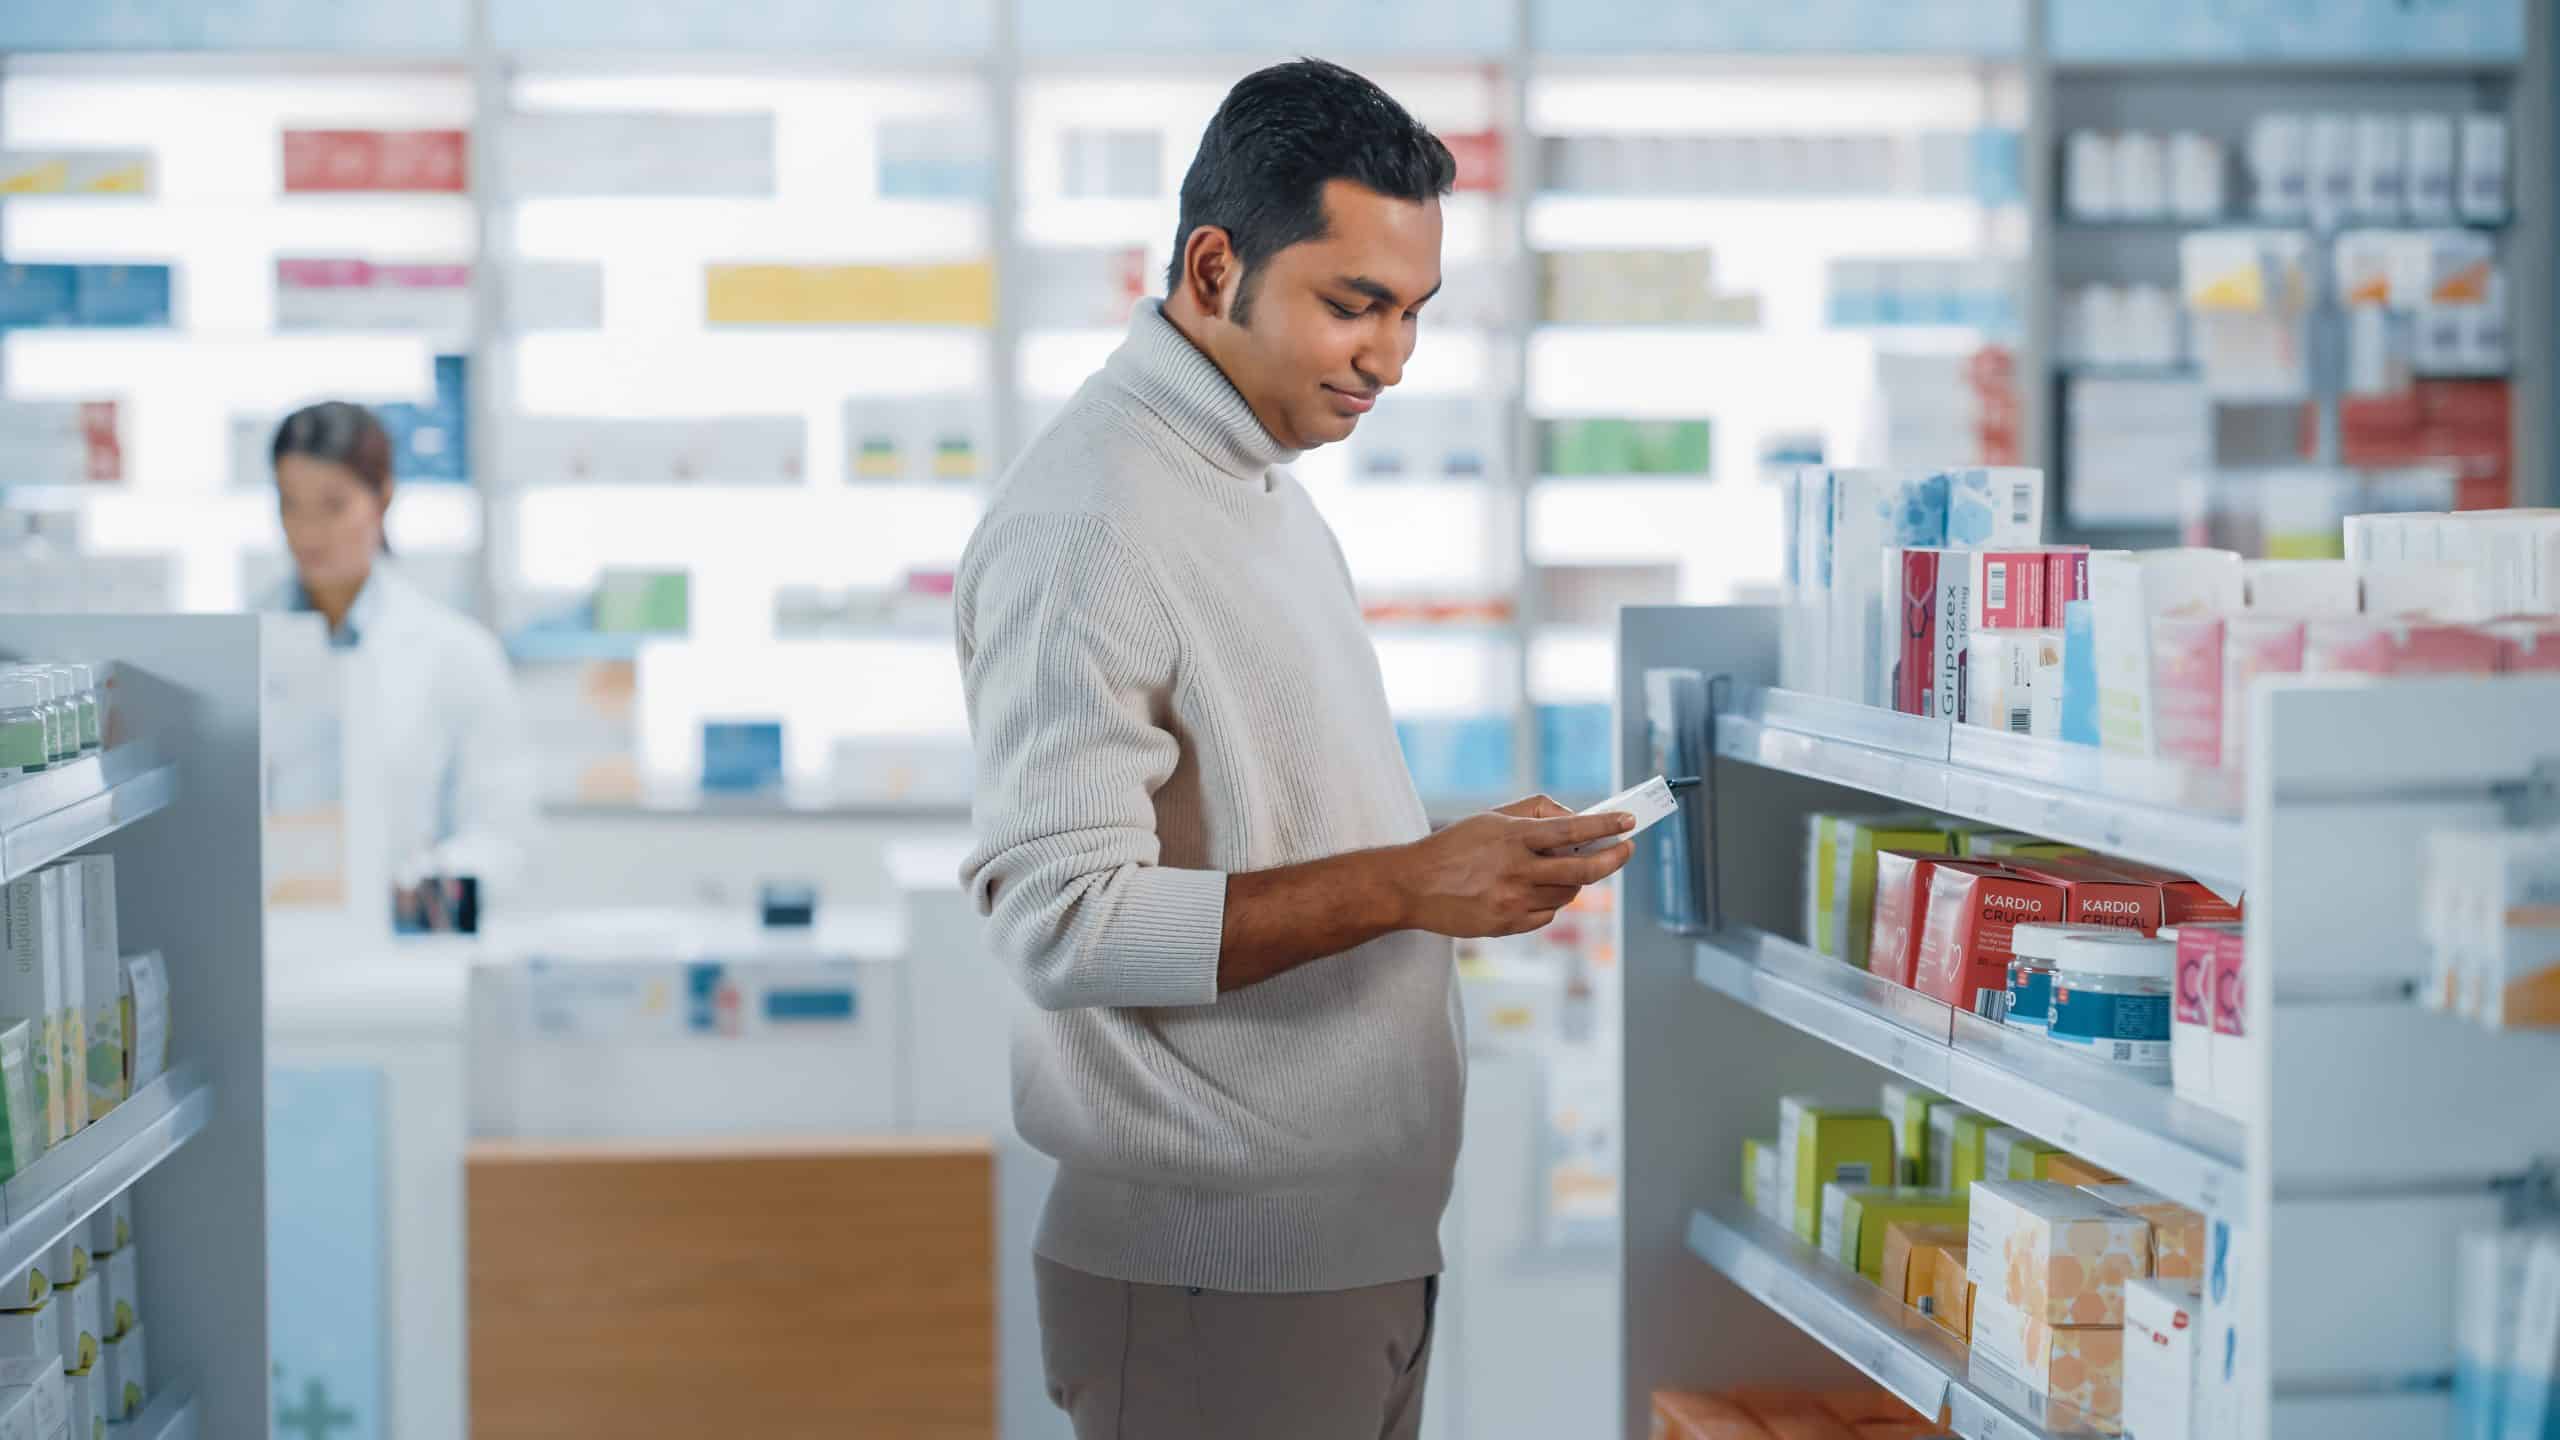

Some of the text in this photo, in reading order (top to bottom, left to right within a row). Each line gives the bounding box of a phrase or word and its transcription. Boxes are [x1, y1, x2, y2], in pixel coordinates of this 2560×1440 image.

[1942, 585, 1957, 715] Gripozex
[1985, 893, 2041, 912] KARDIO
[2083, 899, 2140, 913] KARDIO
[2081, 914, 2148, 928] CRUCIAL
